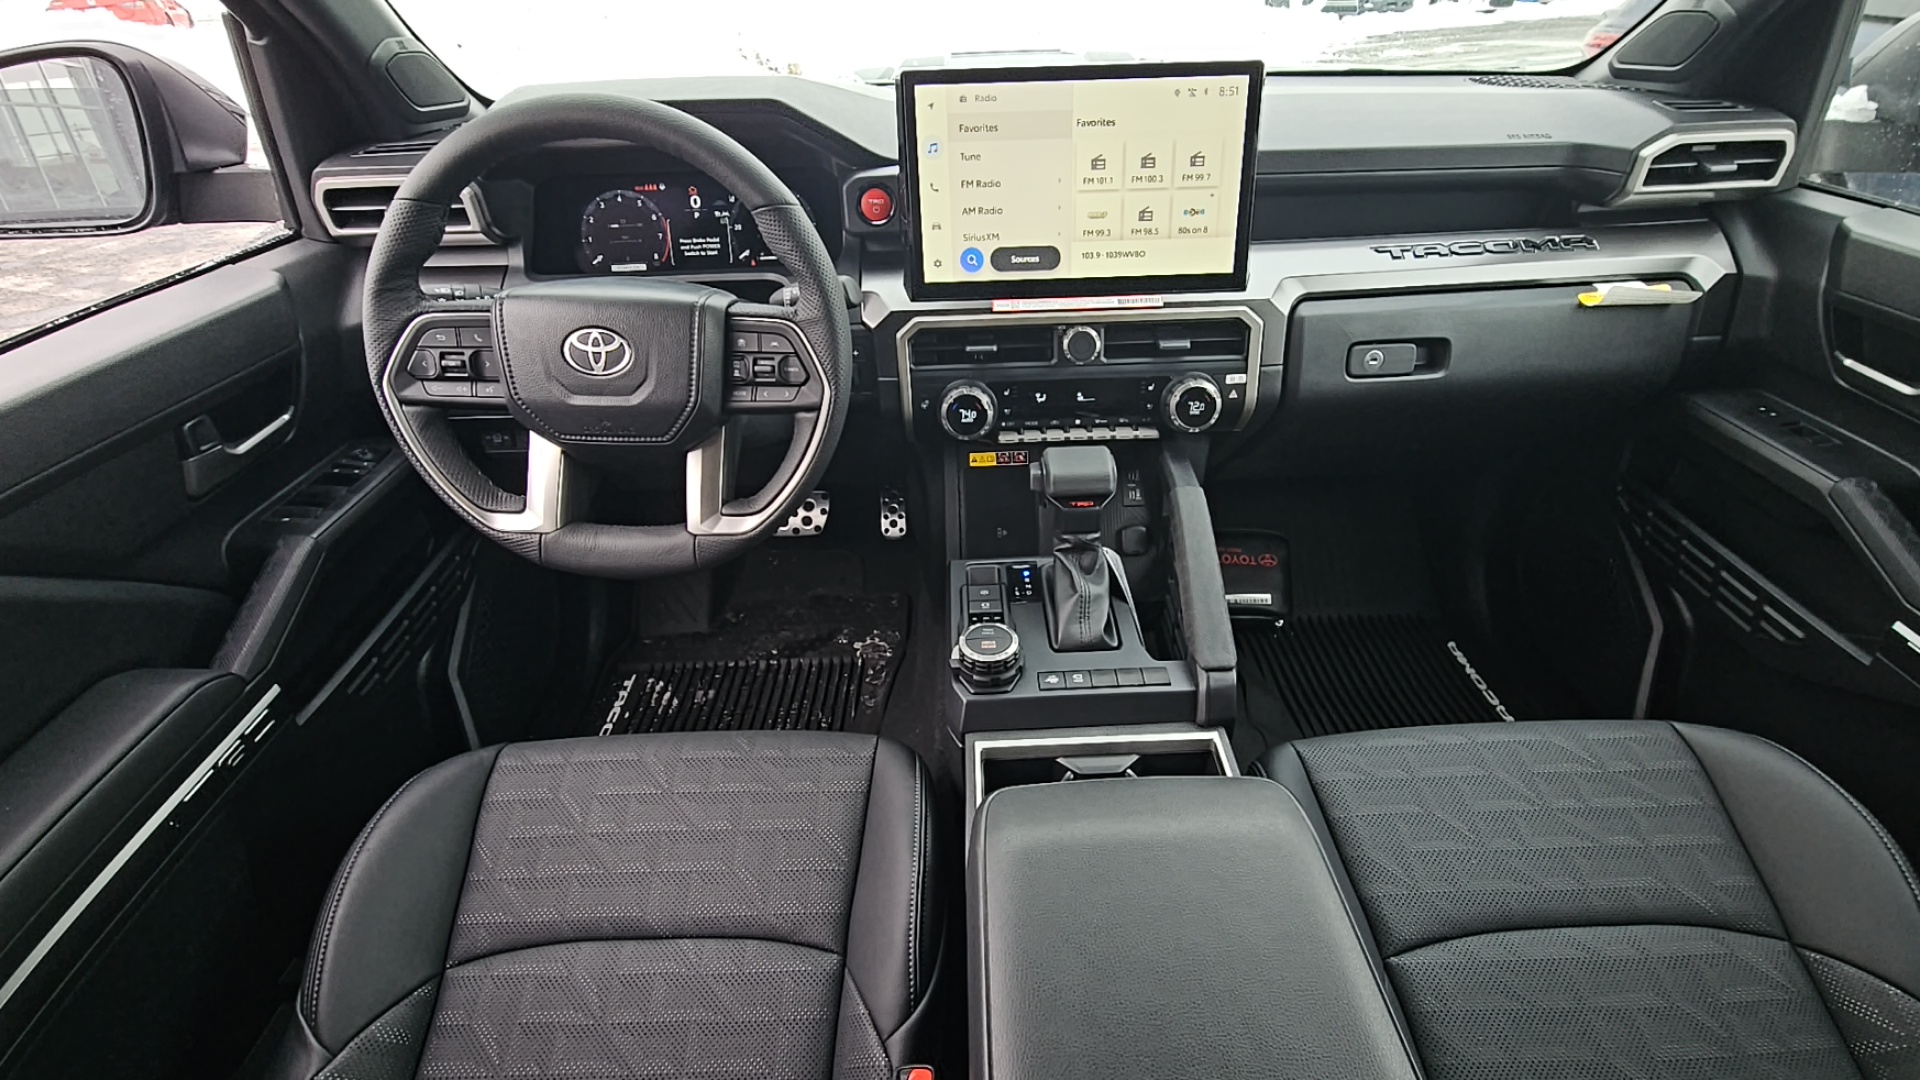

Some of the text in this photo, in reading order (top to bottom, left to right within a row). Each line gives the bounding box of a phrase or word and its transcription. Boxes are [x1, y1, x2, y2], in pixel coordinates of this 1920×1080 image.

[1218, 86, 1239, 97] 8:51
[974, 94, 997, 102] Radio
[1076, 118, 1116, 127] Favorites
[959, 123, 998, 133] Favorites
[960, 152, 981, 161] Tune
[1083, 176, 1113, 185] FM 101.1
[1131, 175, 1163, 183] FM 100.3
[1195, 173, 1211, 181] 99.7
[961, 180, 1001, 188] FM Radio
[690, 195, 701, 208] 0
[962, 206, 1003, 215] AM Radio
[963, 233, 1000, 242] SiriusXM
[1095, 229, 1111, 237] 99.3
[1369, 234, 1600, 260] TACOMA
[1011, 255, 1040, 263] Sources
